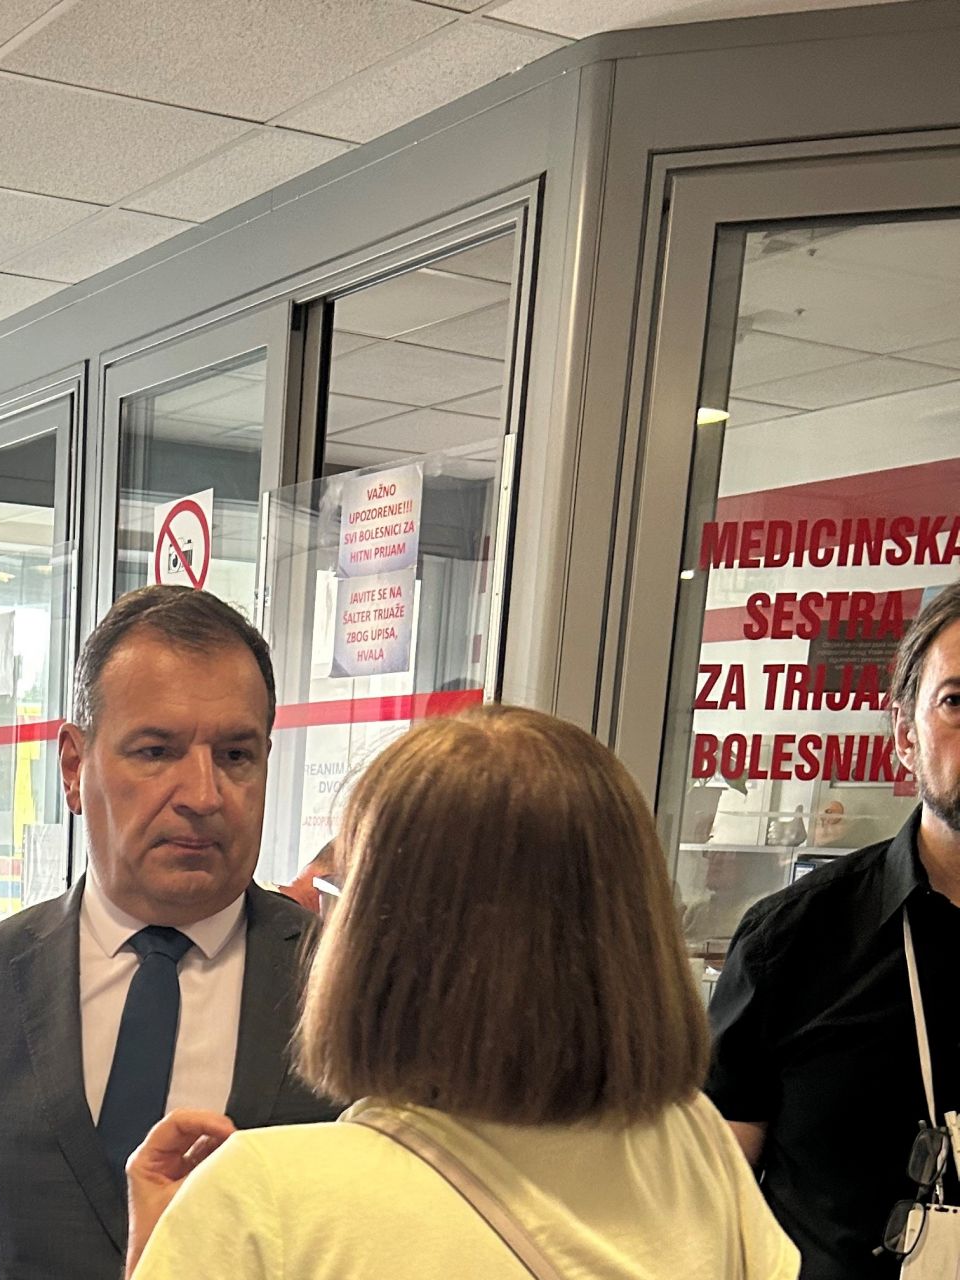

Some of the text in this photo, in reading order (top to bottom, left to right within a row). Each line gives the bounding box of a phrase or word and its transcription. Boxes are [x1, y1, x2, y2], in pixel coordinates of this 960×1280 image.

[367, 484, 396, 500] VAŽNO
[349, 500, 413, 524] UPOZORENJE!!!
[344, 520, 415, 545] SVI BOLESNICI ZA
[698, 515, 960, 570] MEDICINSKA
[350, 543, 406, 563] HITNI PRIJAM
[350, 585, 402, 605] JAVITE SE NA
[343, 603, 405, 625] ŠALTER TRIJAŽE
[743, 590, 906, 640] SESTRA
[346, 626, 398, 644] ZBOG UPISA,
[357, 647, 384, 662] HVALA
[694, 663, 746, 711] ZA
